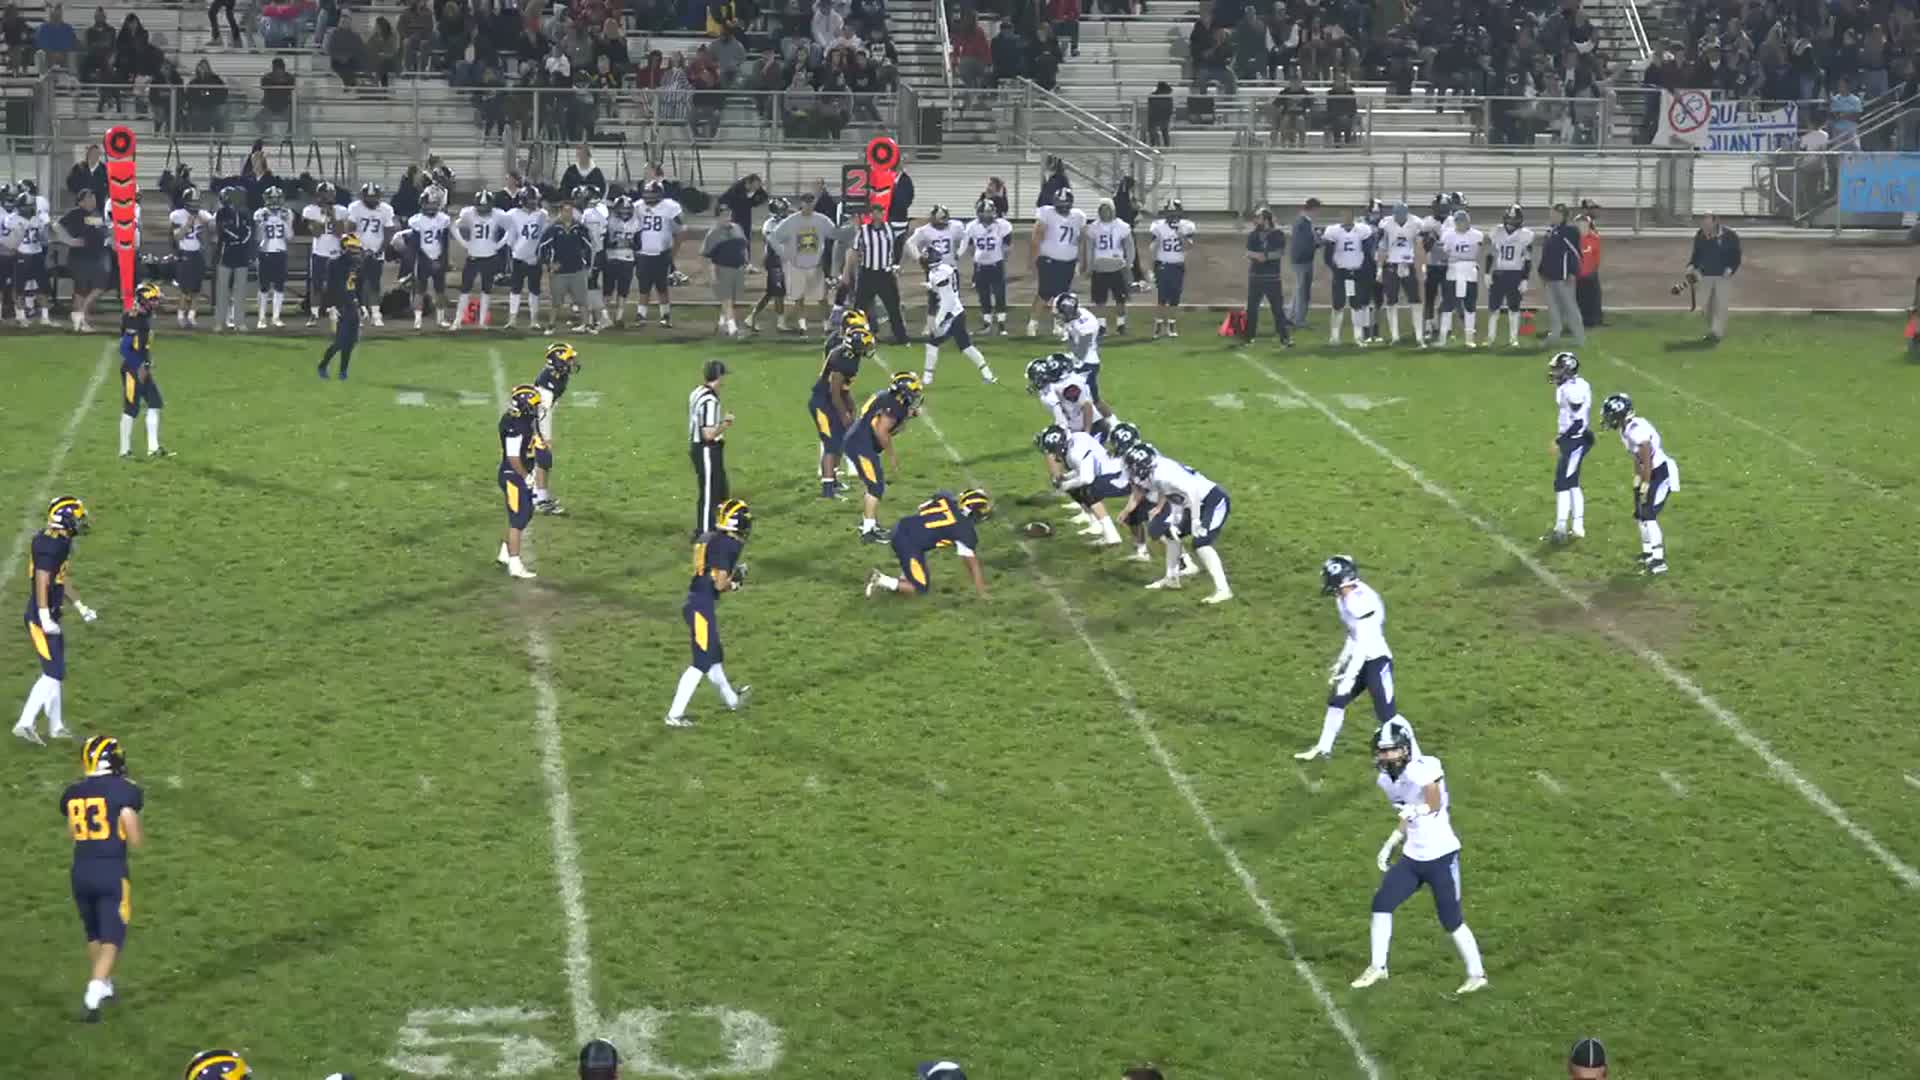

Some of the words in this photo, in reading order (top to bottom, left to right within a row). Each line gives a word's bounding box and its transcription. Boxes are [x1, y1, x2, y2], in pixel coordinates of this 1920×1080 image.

[847, 169, 868, 196] 2
[265, 224, 285, 239] 83
[360, 217, 381, 233] 73
[474, 223, 490, 239] 31
[521, 224, 540, 240] 42
[642, 215, 662, 232] 58
[1059, 225, 1074, 243] 71
[919, 498, 957, 529] 77
[67, 797, 111, 840] 83
[385, 1004, 785, 1079] 50
